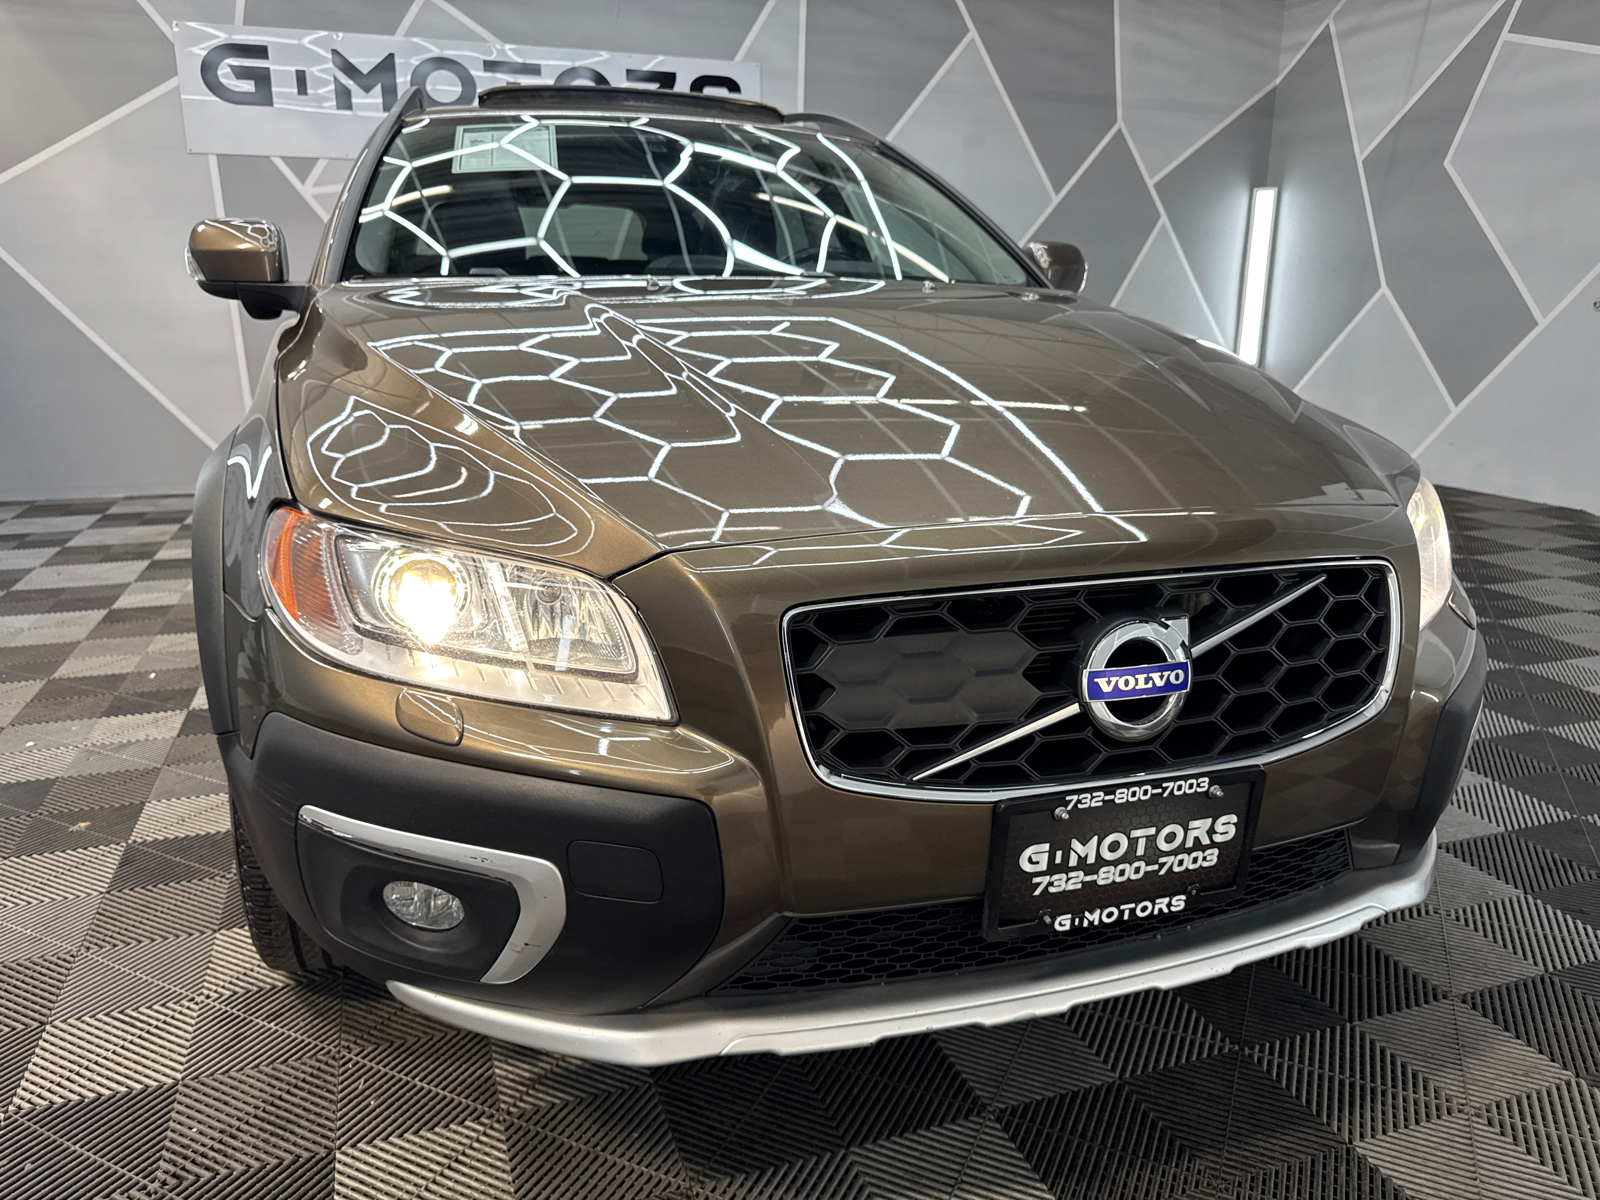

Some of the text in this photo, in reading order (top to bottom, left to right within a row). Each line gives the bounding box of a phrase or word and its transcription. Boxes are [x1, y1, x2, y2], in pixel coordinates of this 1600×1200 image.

[1094, 669, 1185, 693] VOLVO
[1065, 777, 1209, 811] 732-800-7003
[1031, 848, 1219, 896] 732-800-7003
